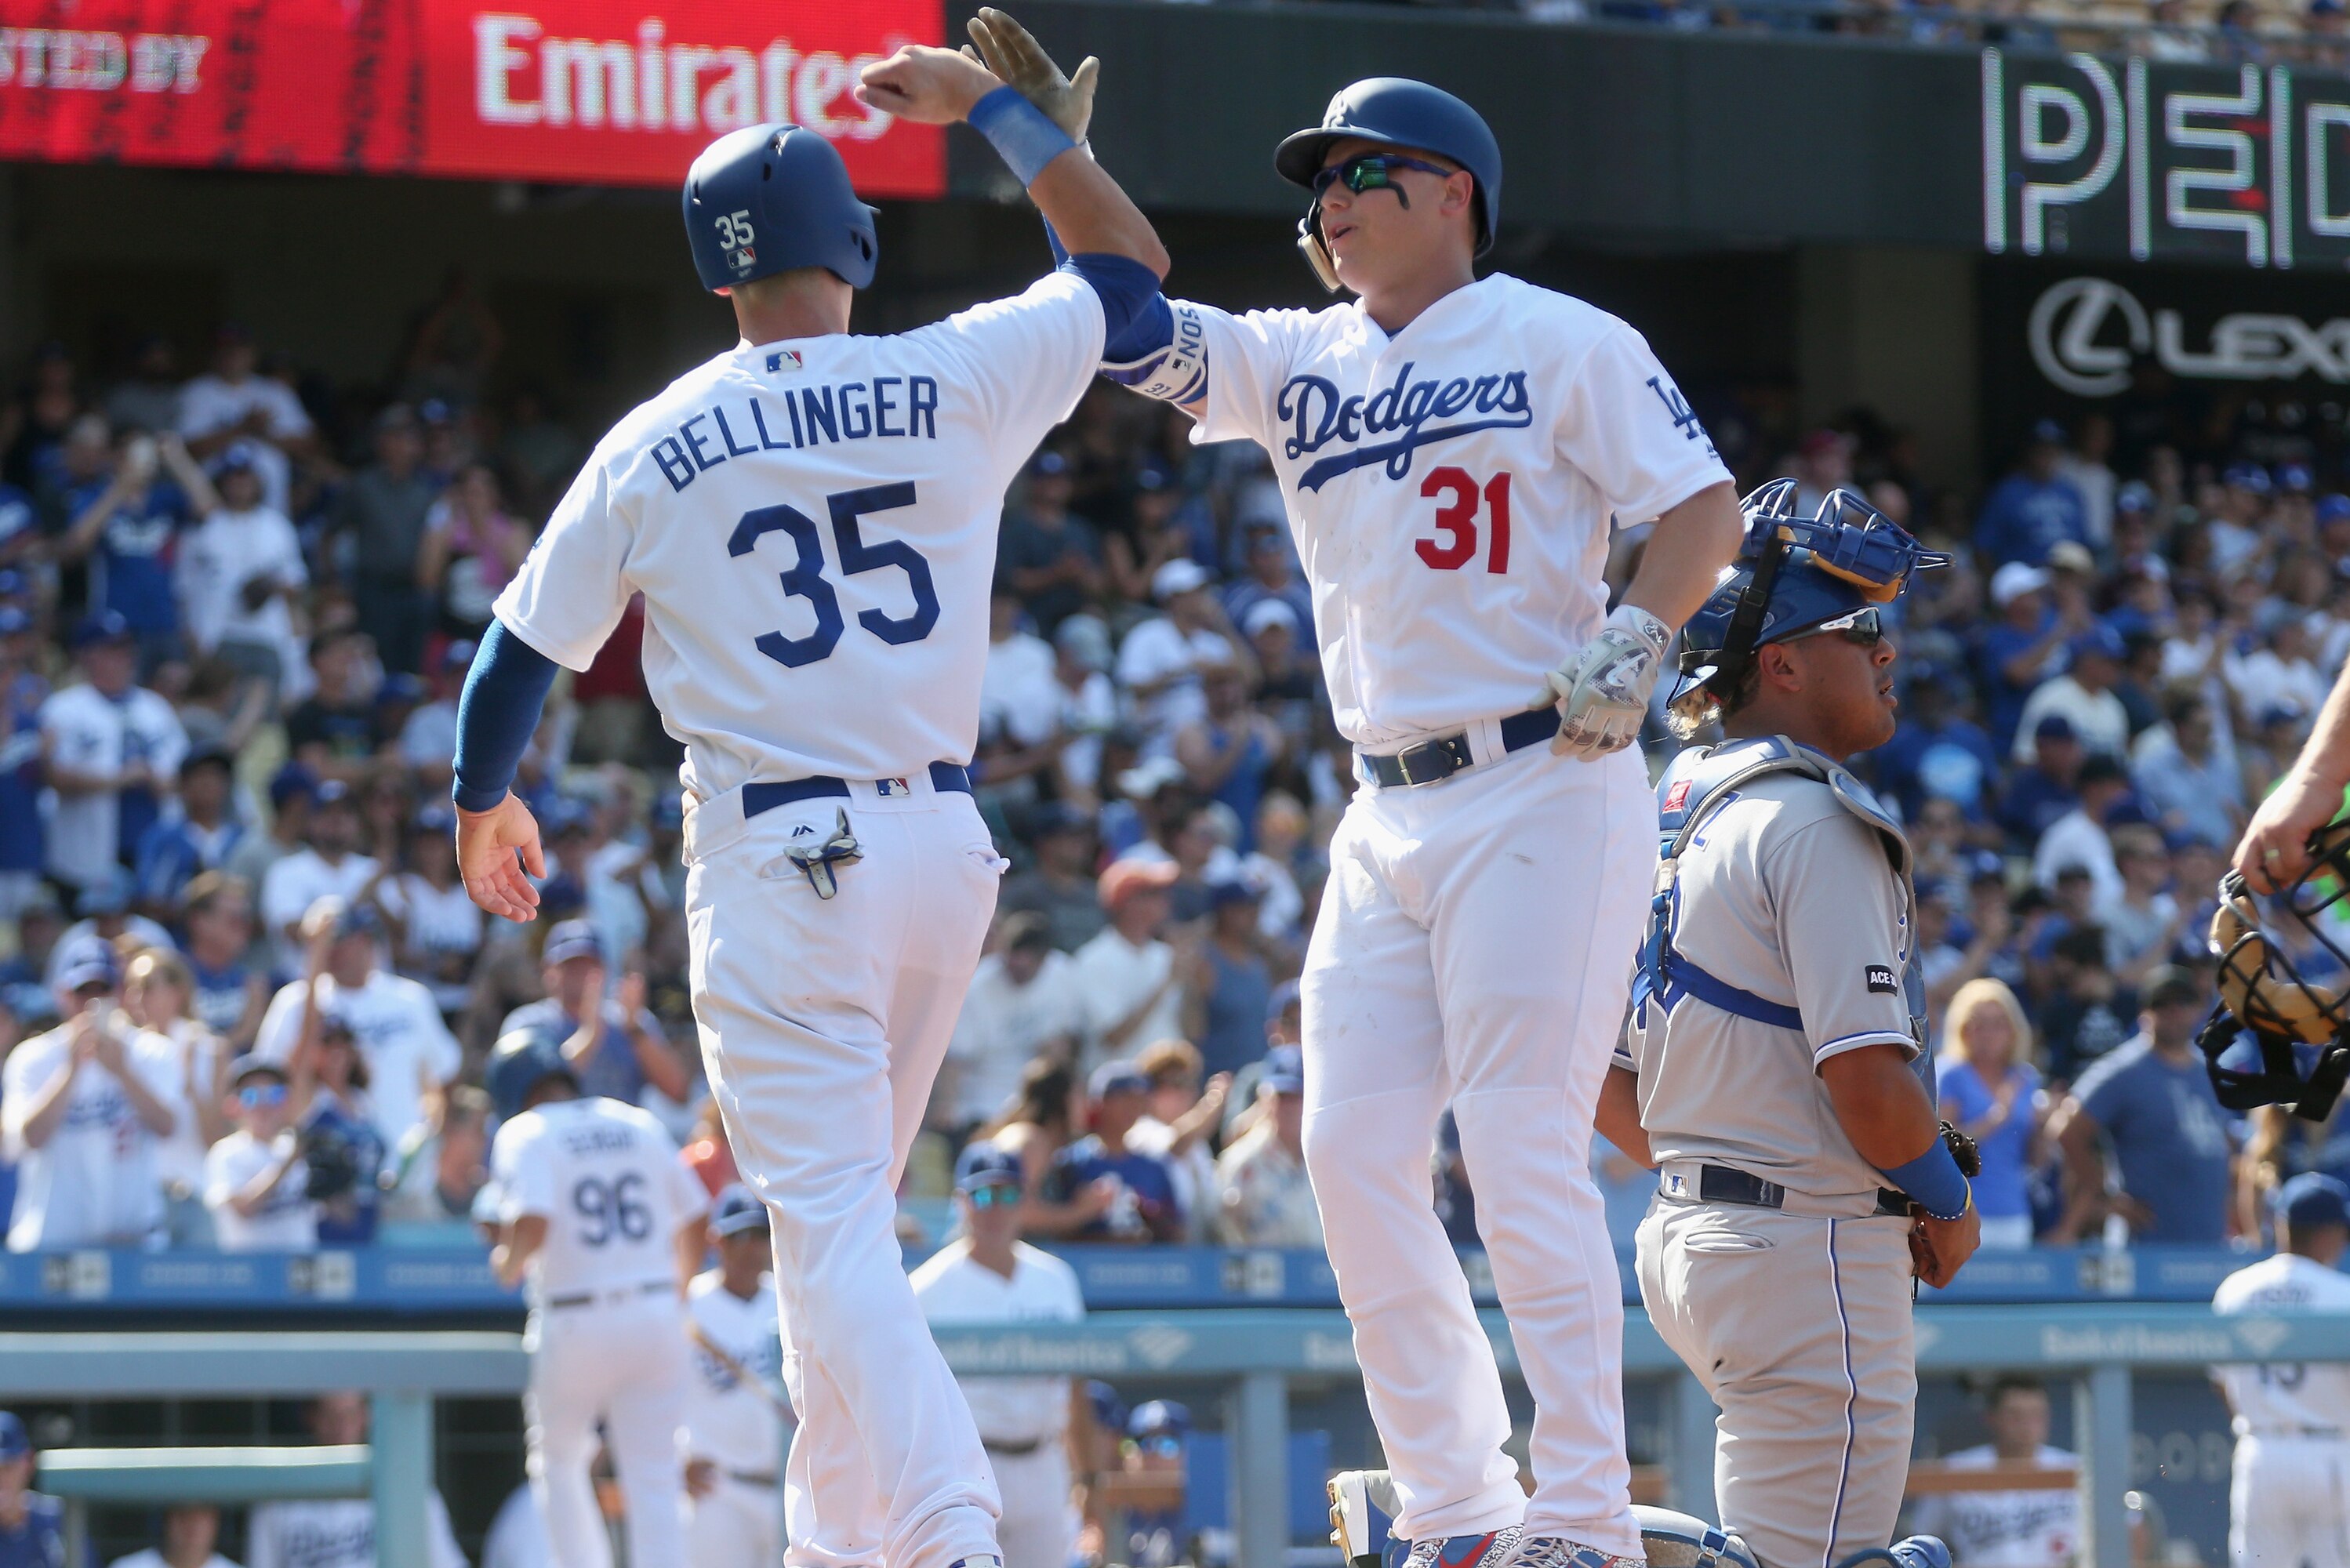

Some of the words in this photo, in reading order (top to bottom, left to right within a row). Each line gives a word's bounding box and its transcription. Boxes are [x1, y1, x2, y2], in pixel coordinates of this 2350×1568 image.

[714, 209, 755, 250] 35
[2156, 307, 2350, 384] LEX
[650, 374, 938, 493] BELLINGER
[1277, 361, 1533, 481] Dodgers
[1415, 466, 1511, 574] 31
[727, 480, 940, 668] 35
[1870, 971, 1891, 985] ACE
[573, 1172, 653, 1248] 96
